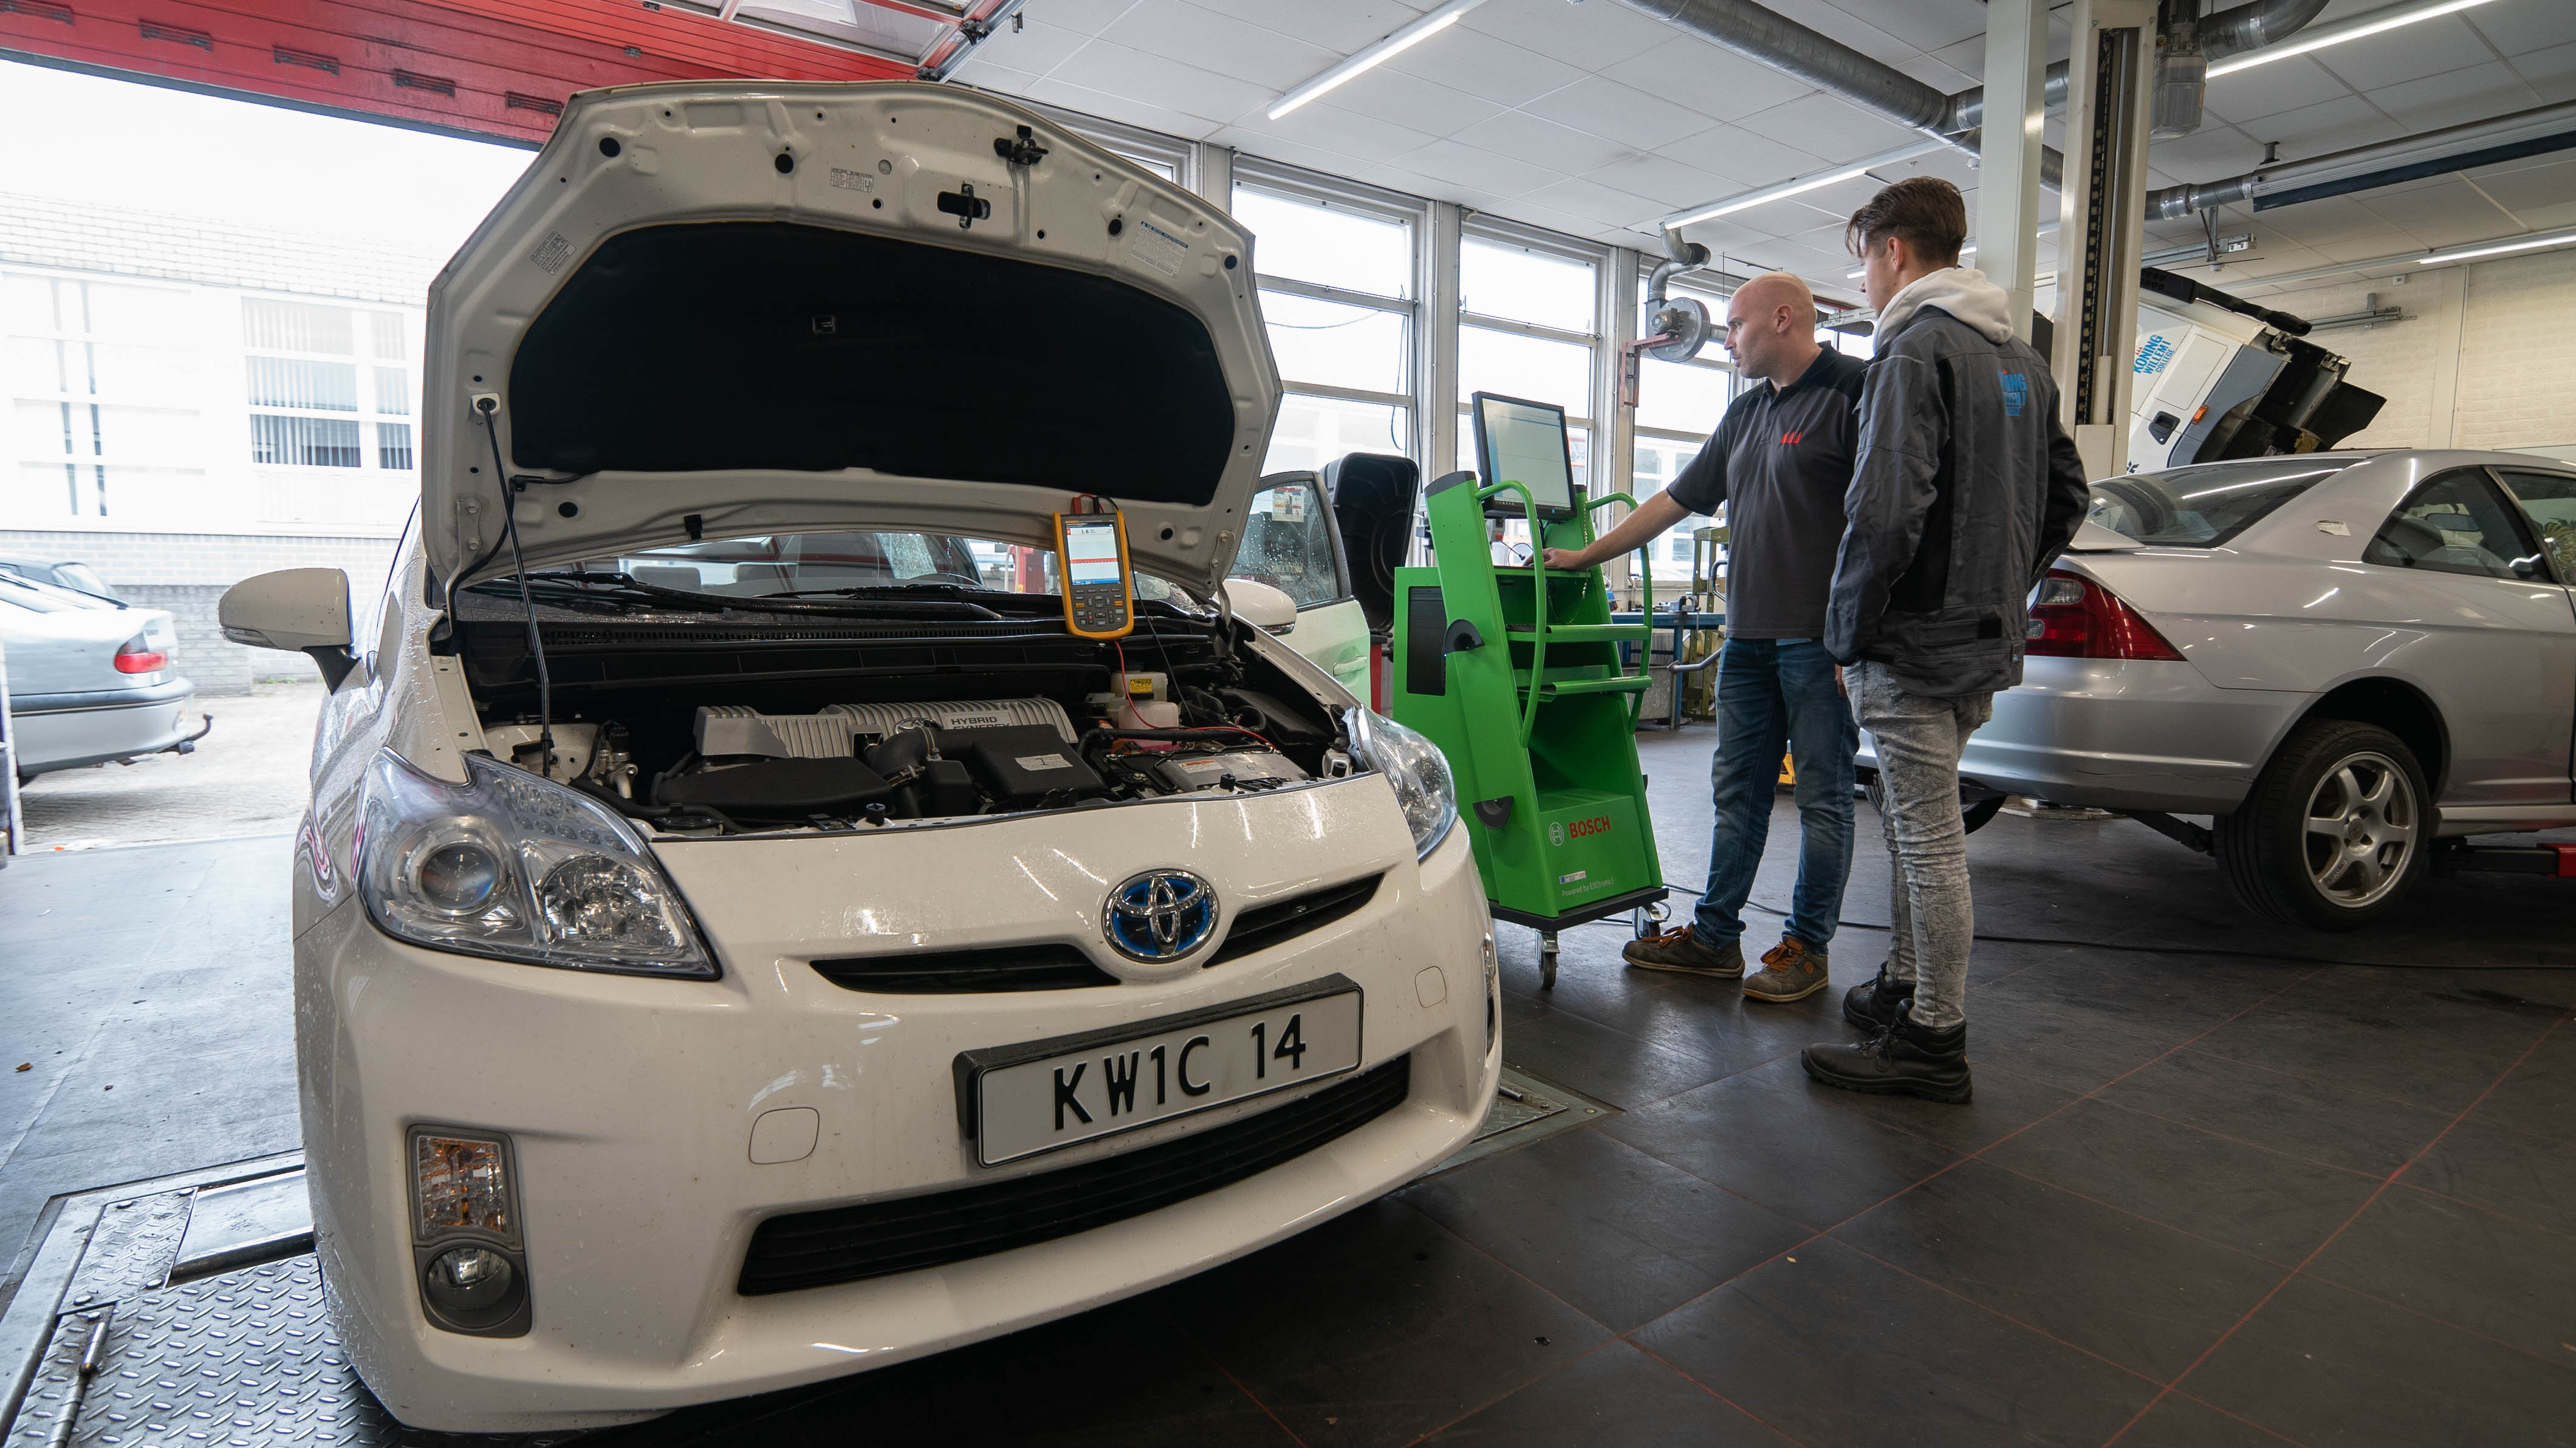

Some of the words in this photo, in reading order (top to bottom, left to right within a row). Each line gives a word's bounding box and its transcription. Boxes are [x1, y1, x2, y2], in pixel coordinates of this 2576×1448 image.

[2134, 334, 2163, 374] KONING
[2143, 344, 2168, 374] WILLEM
[2155, 349, 2174, 373] COLLEGE
[951, 716, 998, 725] HYBRID
[1569, 814, 1611, 839] BOSCH
[1561, 885, 1583, 898] Powered
[1250, 1012, 1306, 1079] 14
